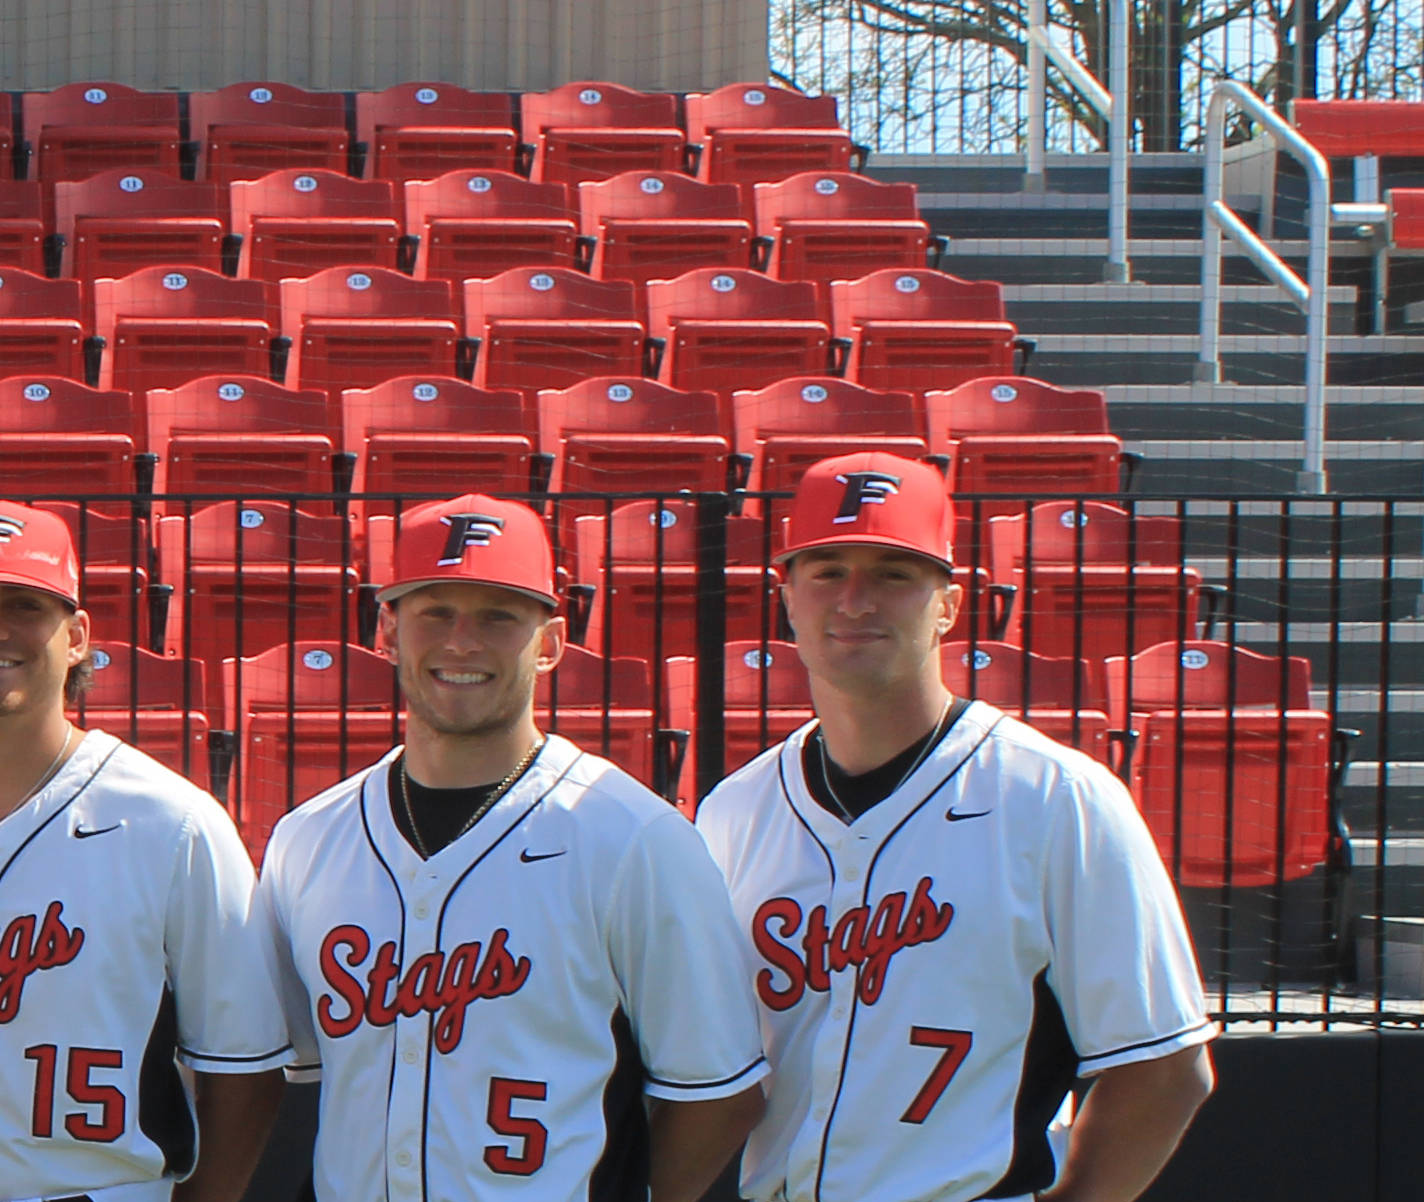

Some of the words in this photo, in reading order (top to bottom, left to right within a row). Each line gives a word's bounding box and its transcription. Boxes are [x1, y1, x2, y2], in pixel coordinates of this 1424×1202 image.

[436, 512, 505, 567] F
[832, 470, 902, 525] F
[317, 924, 531, 1055] Stags
[752, 876, 955, 1012] Stags
[24, 1043, 127, 1143] 15
[900, 1025, 973, 1125] 7
[483, 1076, 549, 1176] 5
